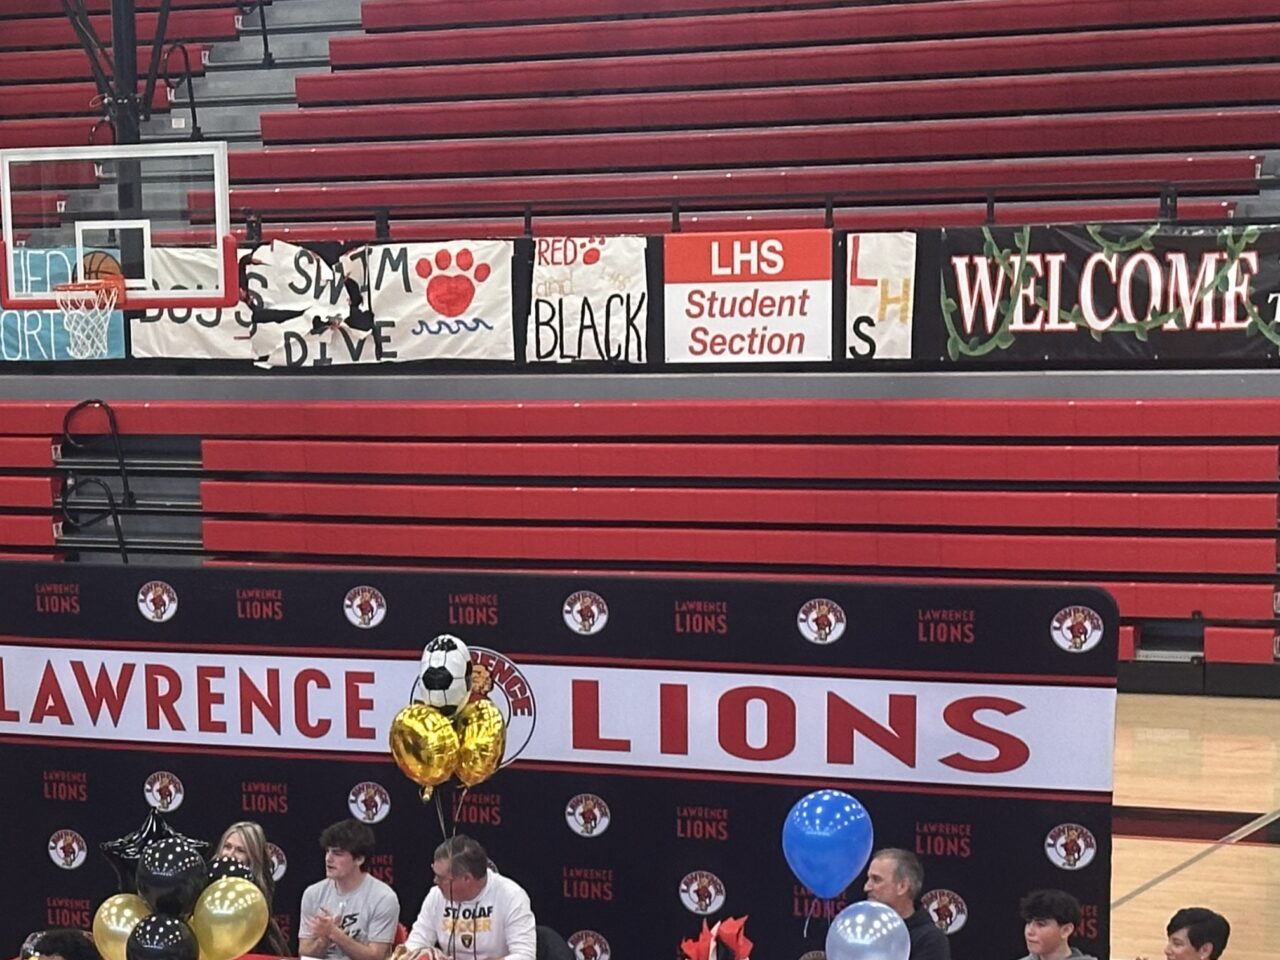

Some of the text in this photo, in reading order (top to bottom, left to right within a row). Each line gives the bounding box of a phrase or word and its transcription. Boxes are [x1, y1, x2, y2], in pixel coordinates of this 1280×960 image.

[538, 238, 578, 266] RED
[709, 239, 785, 276] LHS
[535, 269, 574, 298] and
[950, 250, 1260, 334] WELCOME
[685, 285, 810, 319] Student
[534, 291, 646, 362] BLACK
[284, 319, 398, 367] DIVE
[688, 326, 805, 357] Section
[35, 582, 80, 594] LAWRENCE
[236, 588, 282, 600] LAWRENCE
[36, 595, 80, 614] LIONS
[448, 593, 498, 605] LAWRENCE
[675, 600, 728, 613] LAWRENCE
[236, 600, 284, 620] LIONS
[448, 606, 499, 626] LIONS
[918, 608, 975, 622] LAWRENCE
[674, 614, 728, 634] LIONS
[917, 622, 975, 644] LIONS
[571, 678, 1031, 774] LIONS
[43, 770, 87, 783] LAWRENCE
[43, 782, 88, 802] LIONS
[242, 781, 288, 795] LAWRENCE
[242, 794, 288, 814] LIONS
[676, 806, 729, 820] LAWRENCE
[452, 805, 502, 826] LIONS
[676, 820, 729, 841] LIONS
[915, 821, 972, 835] LAWRENCE
[915, 835, 971, 858] LIONS
[562, 866, 613, 881] LAWRENCE
[563, 880, 613, 901] LIONS
[46, 896, 90, 910] LAWRENCE
[461, 905, 494, 920] OLAF
[47, 908, 91, 929] LIONS
[442, 919, 492, 933] SOCCER
